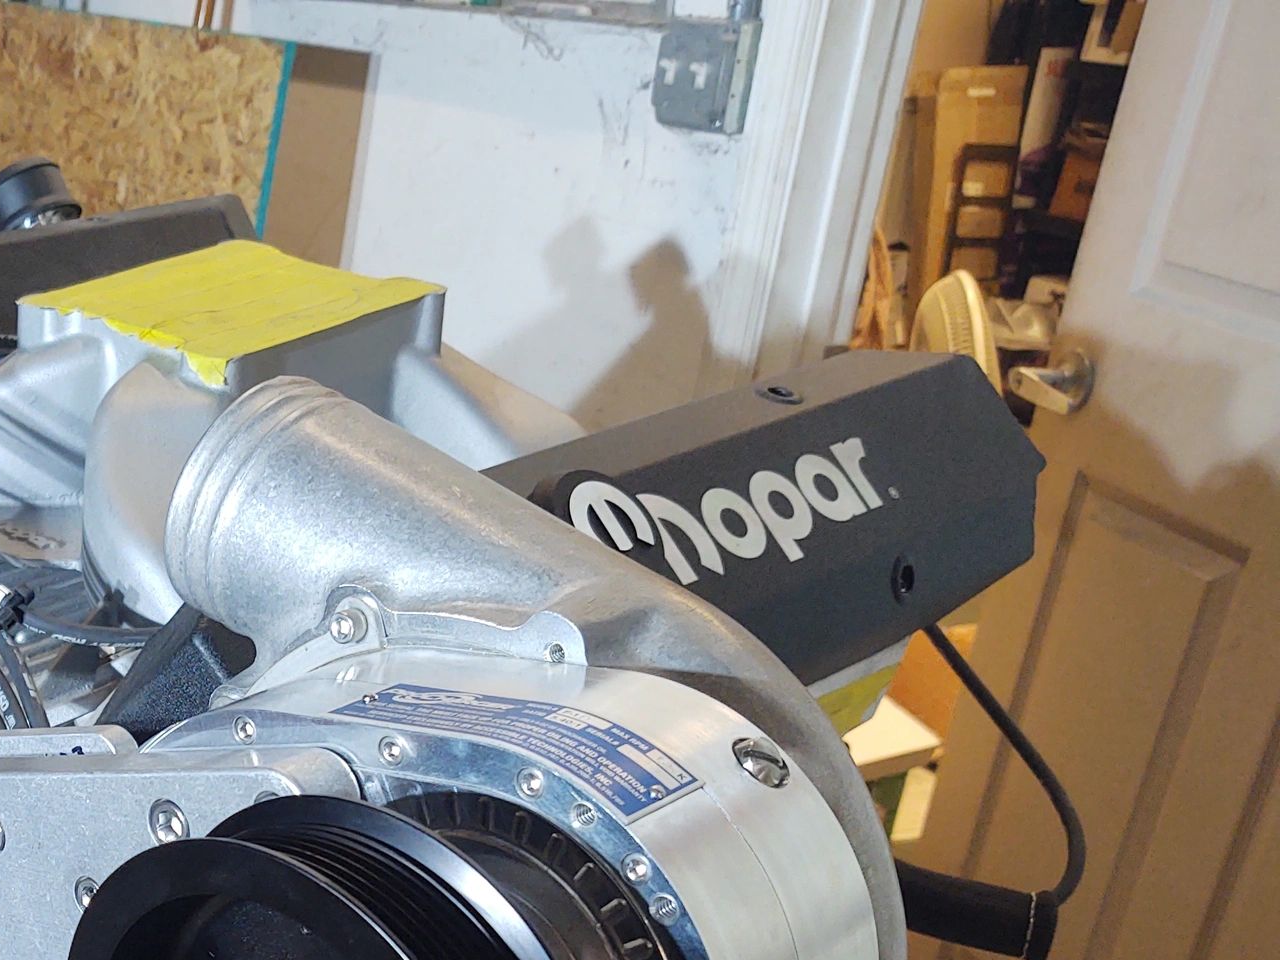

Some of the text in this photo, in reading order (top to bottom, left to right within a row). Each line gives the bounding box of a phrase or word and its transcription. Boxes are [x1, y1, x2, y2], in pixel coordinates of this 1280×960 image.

[569, 437, 883, 585] Mopar
[576, 744, 598, 758] AND
[596, 755, 647, 793] OPERATION
